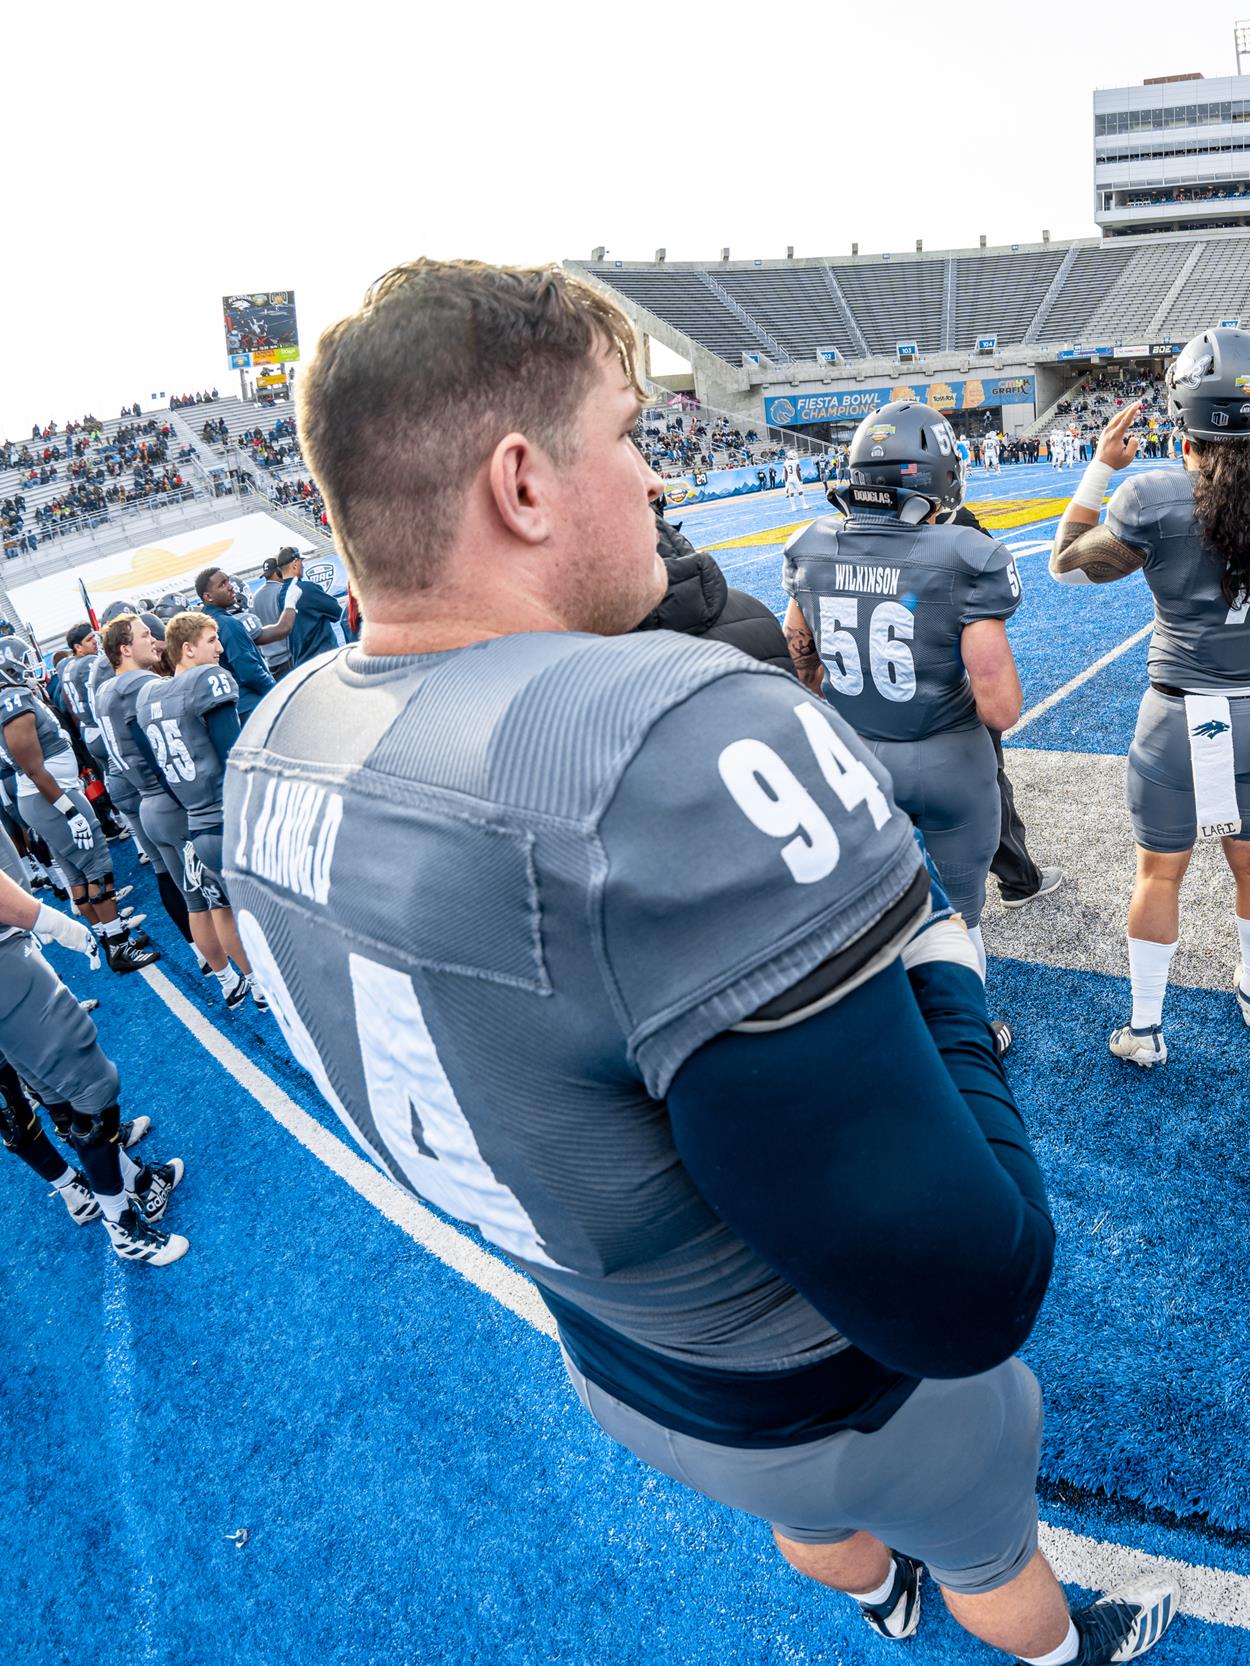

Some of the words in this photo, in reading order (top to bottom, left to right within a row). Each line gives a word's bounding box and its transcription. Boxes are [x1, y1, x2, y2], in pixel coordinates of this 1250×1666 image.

[797, 395, 840, 410] FIESTA
[842, 392, 881, 405] BOWL
[801, 403, 877, 420] CHAMPIONS
[788, 465, 794, 474] 3
[835, 564, 901, 595] WILKINSON
[819, 596, 917, 703] 56
[207, 673, 233, 698] 25
[5, 693, 23, 712] 54
[146, 719, 197, 784] 25
[717, 701, 893, 884] 94
[146, 1181, 173, 1212] adidas
